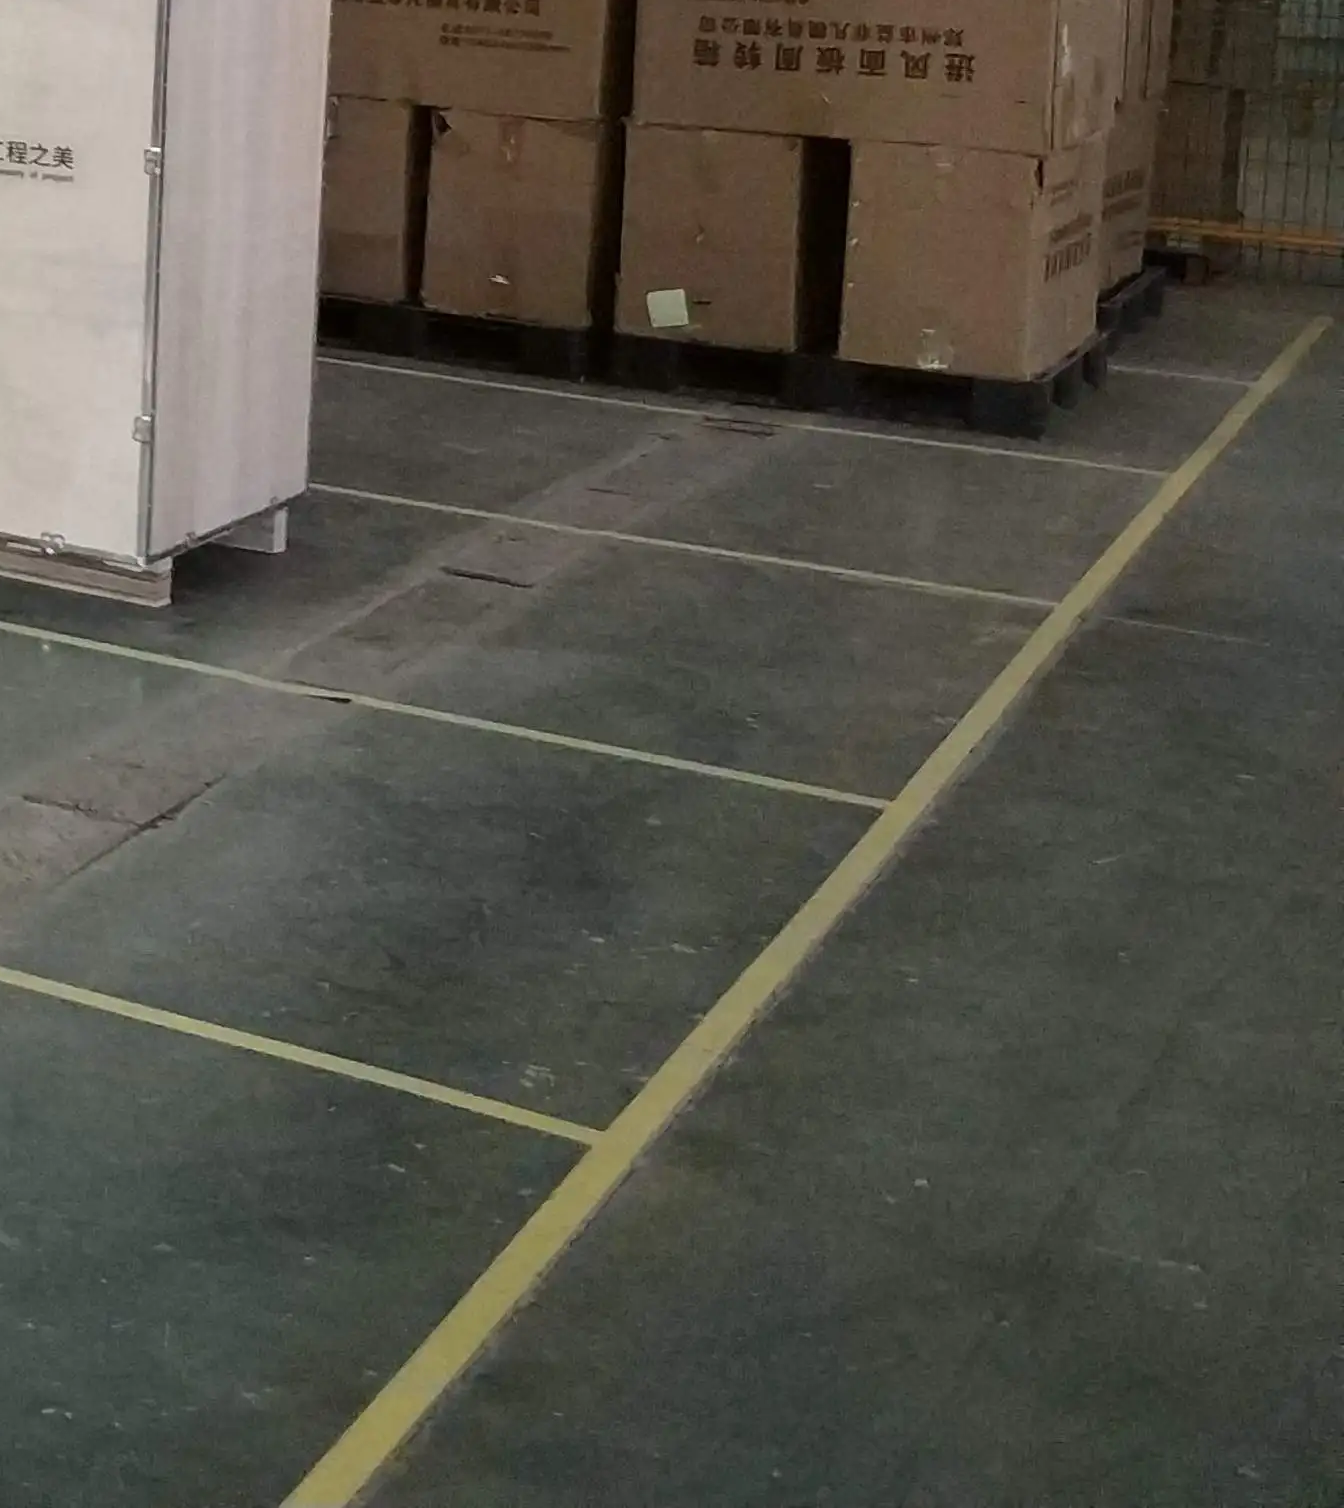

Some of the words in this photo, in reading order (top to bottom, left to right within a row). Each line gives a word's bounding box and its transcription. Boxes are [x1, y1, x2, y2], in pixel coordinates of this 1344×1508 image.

[693, 38, 976, 82] 进风面板周转箱
